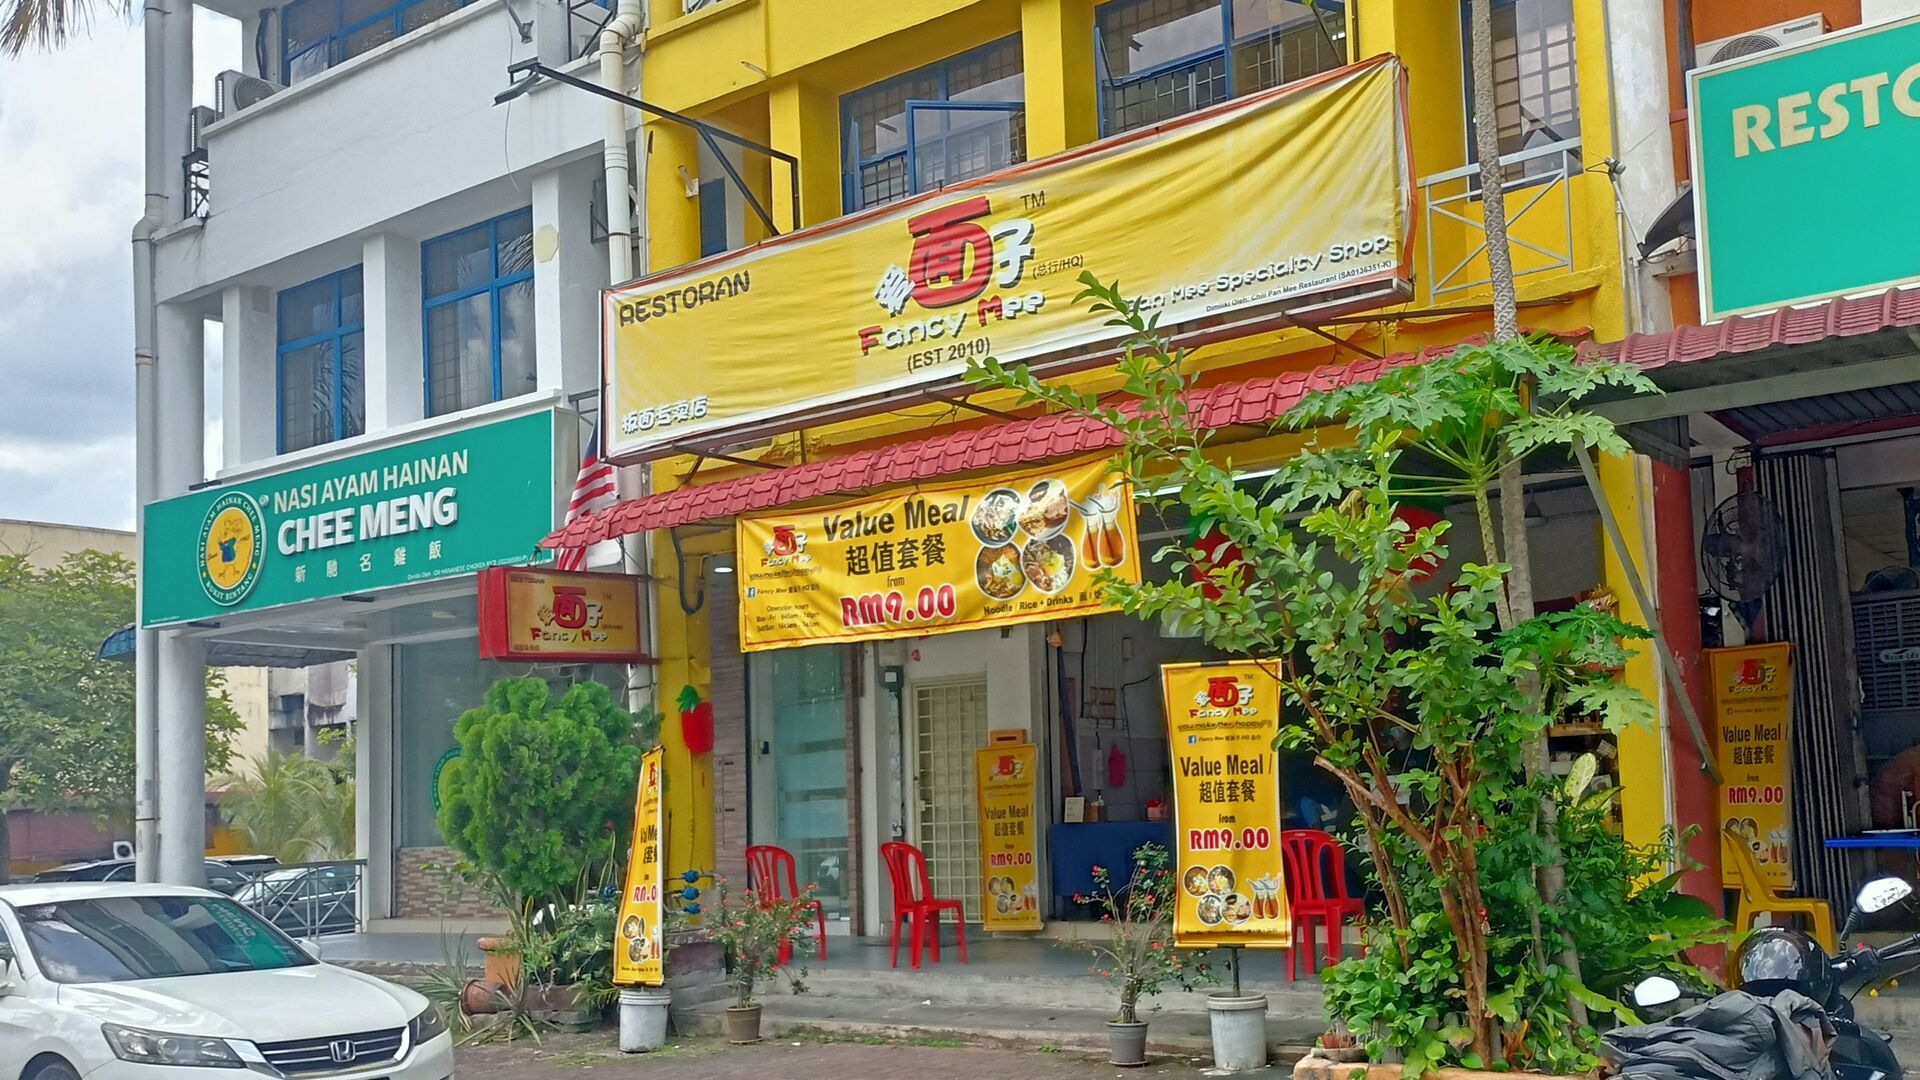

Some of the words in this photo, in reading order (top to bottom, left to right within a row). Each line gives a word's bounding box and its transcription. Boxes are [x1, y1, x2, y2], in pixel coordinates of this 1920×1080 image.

[1020, 190, 1046, 210] TM
[1171, 283, 1210, 304] Mee
[1216, 252, 1323, 293] Specialty
[1329, 233, 1391, 263] Shop
[619, 270, 750, 327] RESTORAN
[1268, 287, 1282, 299] Pan
[1283, 284, 1298, 295] Mee
[1299, 275, 1338, 290] Restaurant
[858, 310, 967, 356] Fancy
[977, 290, 1046, 328] Mee
[906, 347, 944, 373] (EST
[949, 336, 991, 362] 2010)
[274, 484, 317, 514] NASI
[321, 470, 379, 504] AYAM
[382, 449, 468, 489] HAINAN
[278, 507, 355, 556] CHEE
[359, 486, 457, 540] MENG
[823, 511, 895, 542] Value
[904, 494, 970, 530] Meal
[846, 533, 946, 577] 超值套餐
[887, 575, 906, 588] from
[840, 584, 957, 628] RM9.00
[984, 604, 1013, 615] Noodle
[1020, 600, 1038, 610] Rice
[1046, 596, 1073, 606] Drinks
[530, 627, 578, 643] Fancy
[581, 629, 608, 642] Mee
[1189, 709, 1230, 718] Fancy
[1233, 707, 1258, 717] Mee
[1722, 725, 1751, 743] Value
[1754, 723, 1782, 742] Meal
[1179, 756, 1222, 778] Value
[1226, 754, 1264, 776] Meal
[1733, 745, 1775, 765] 超值套餐
[1199, 780, 1256, 803] 超值套餐
[1728, 785, 1784, 805] RM9.00
[984, 806, 1007, 821] Value
[1009, 804, 1029, 818] Meal
[1218, 814, 1236, 824] from
[994, 821, 1024, 836] 超值套餐
[1189, 827, 1270, 851] RM9.00
[990, 852, 1032, 867] RM9.00
